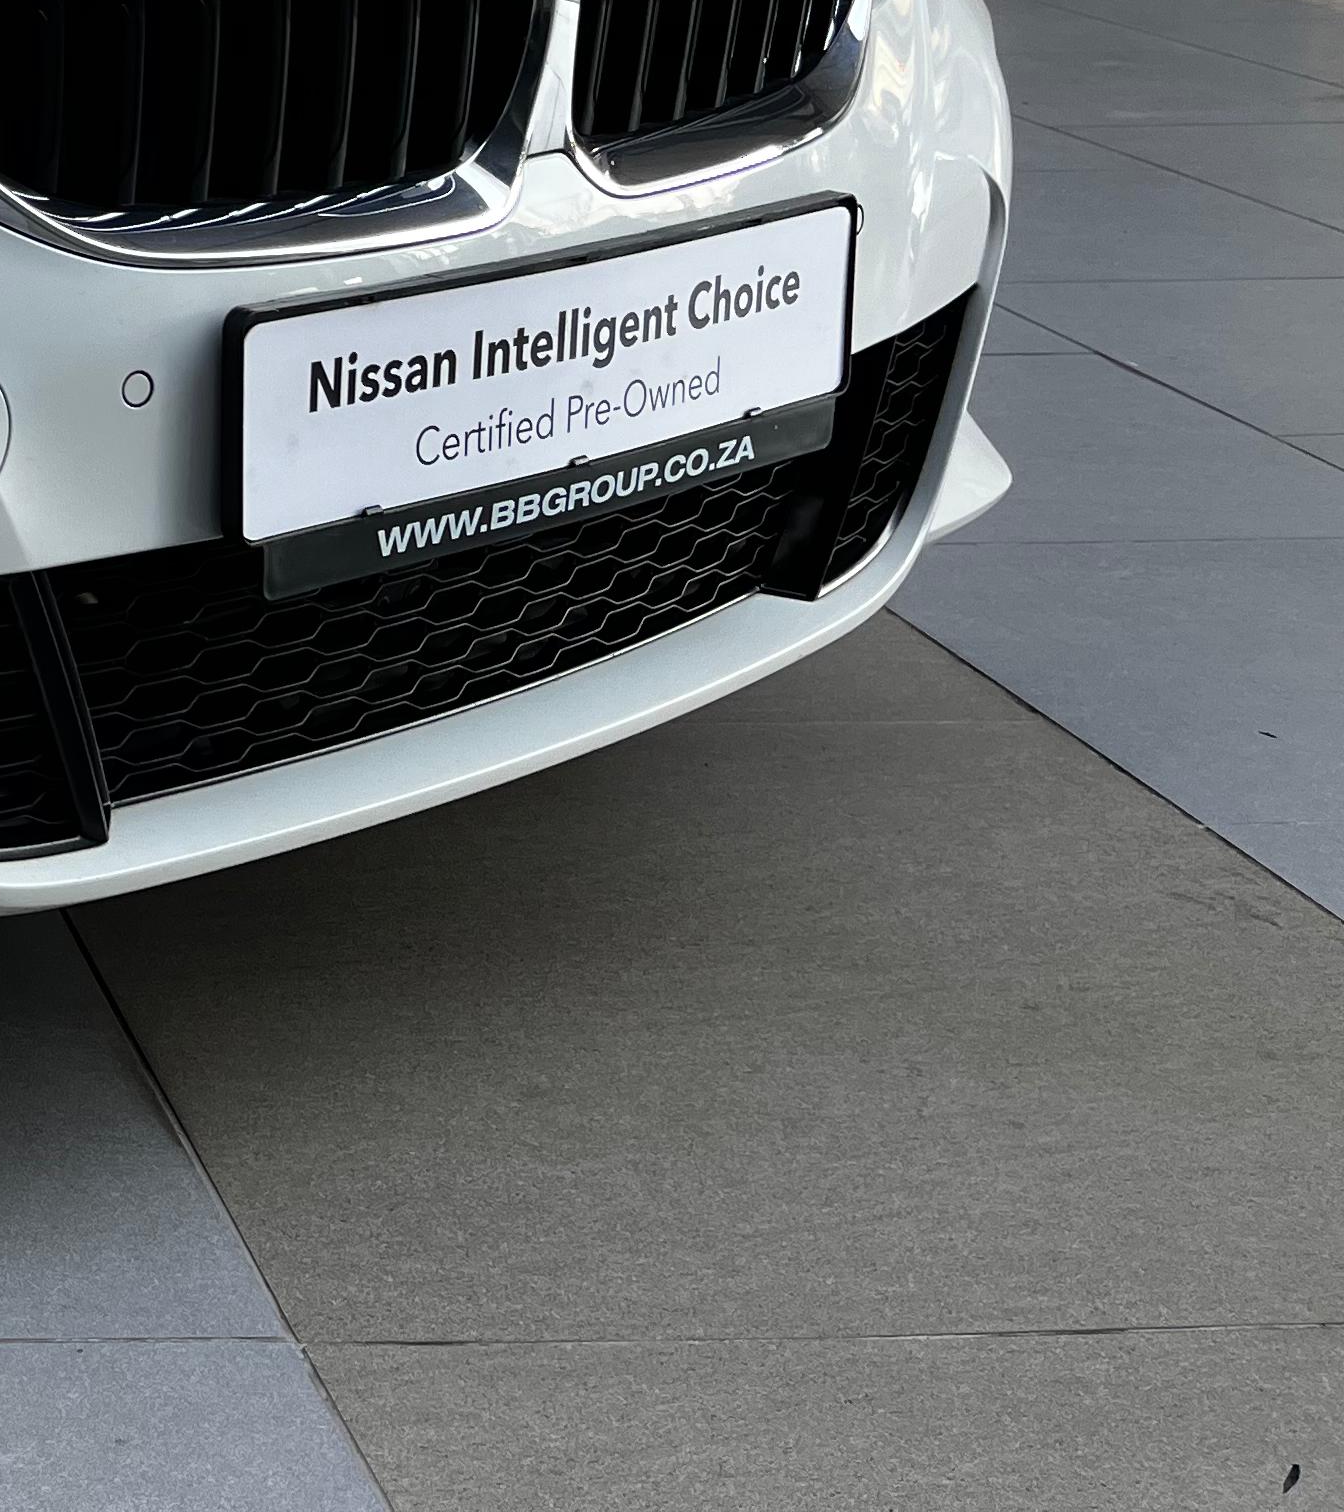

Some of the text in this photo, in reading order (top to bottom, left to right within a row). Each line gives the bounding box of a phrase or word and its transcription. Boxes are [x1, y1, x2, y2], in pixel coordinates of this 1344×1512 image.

[309, 265, 800, 413] Nissan Intelligent Choice
[416, 356, 721, 465] Certified Pre-Owned
[377, 435, 756, 557] WWW.BBGROUP.CO.ZA
